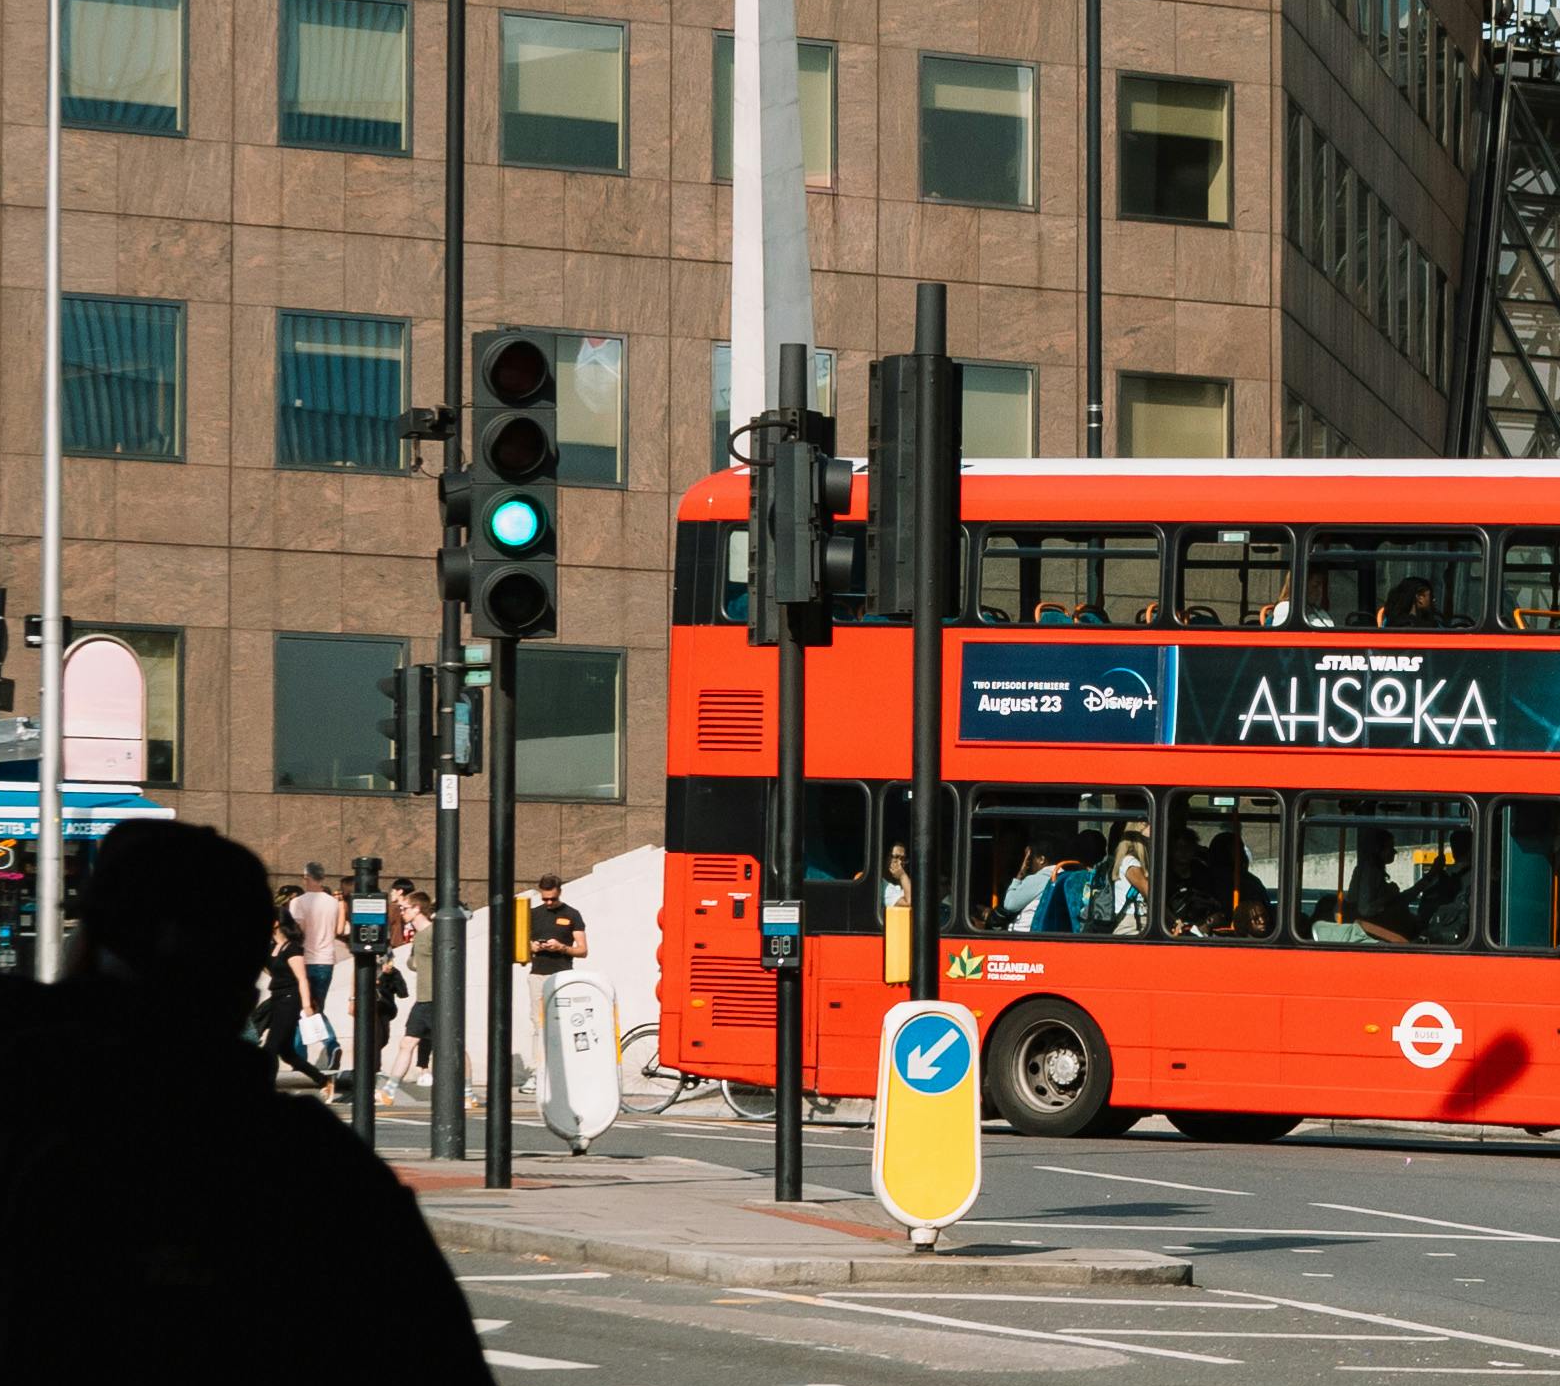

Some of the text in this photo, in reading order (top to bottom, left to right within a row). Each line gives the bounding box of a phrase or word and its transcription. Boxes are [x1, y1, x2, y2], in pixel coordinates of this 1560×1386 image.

[1315, 654, 1423, 673] STAR WARS
[972, 681, 1071, 691] TWO EPISODE PREMIERE
[978, 693, 1062, 716] August 23
[1079, 683, 1158, 720] Disney+
[1238, 675, 1497, 746] AHSOKA
[1414, 1030, 1440, 1039] BUSES
